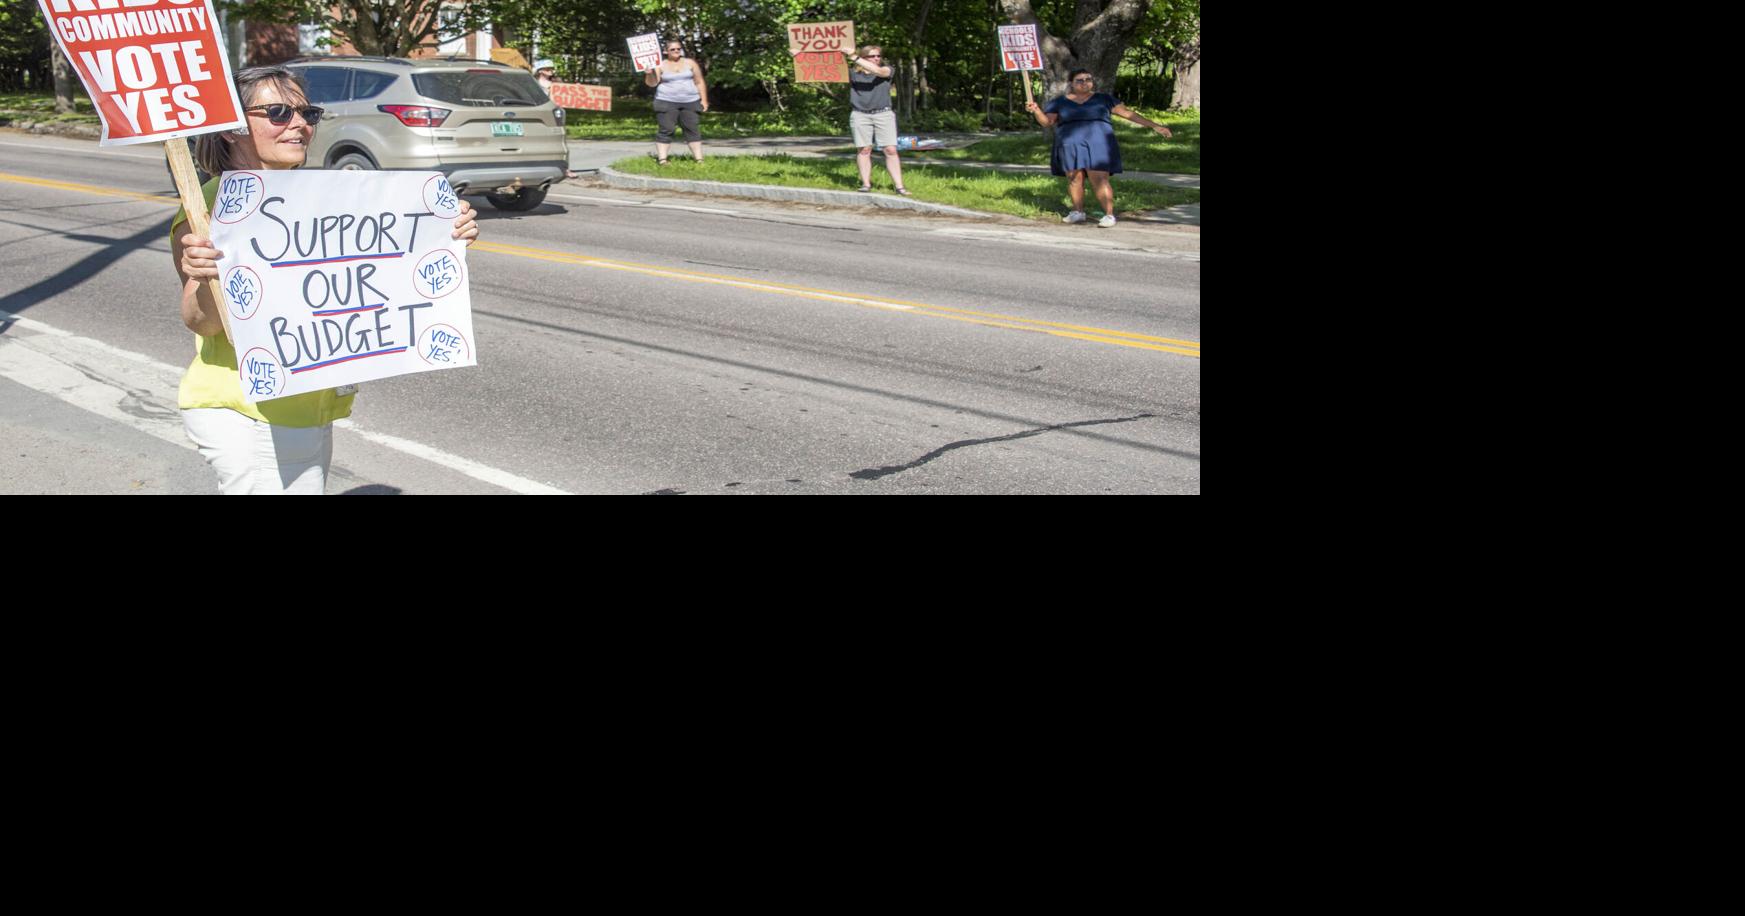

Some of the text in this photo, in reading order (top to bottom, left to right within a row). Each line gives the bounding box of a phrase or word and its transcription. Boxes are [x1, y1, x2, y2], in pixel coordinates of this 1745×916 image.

[56, 6, 207, 43] COMMUNITY
[791, 25, 848, 40] THANK
[797, 39, 841, 51] YOU
[1002, 34, 1035, 47] KIDS
[79, 40, 212, 93] VOTE
[795, 52, 844, 64] VOTE
[1007, 51, 1036, 61] VOTE
[800, 64, 842, 81] YES
[552, 85, 588, 98] PASS
[110, 84, 207, 135] YES
[553, 95, 610, 111] BUDGET
[223, 177, 256, 195] VOTE
[219, 194, 250, 218] YES!
[250, 196, 435, 262] SUPPORT
[418, 255, 452, 280] VOTE
[226, 269, 247, 299] VOTE
[302, 263, 390, 309] OUR
[427, 265, 459, 295] YES!
[233, 278, 258, 313] YES!
[269, 302, 434, 368] BUDGET
[430, 329, 461, 349] VOTE
[427, 343, 462, 365] YES!
[246, 357, 276, 380] VOTE
[248, 377, 276, 397] YES!
